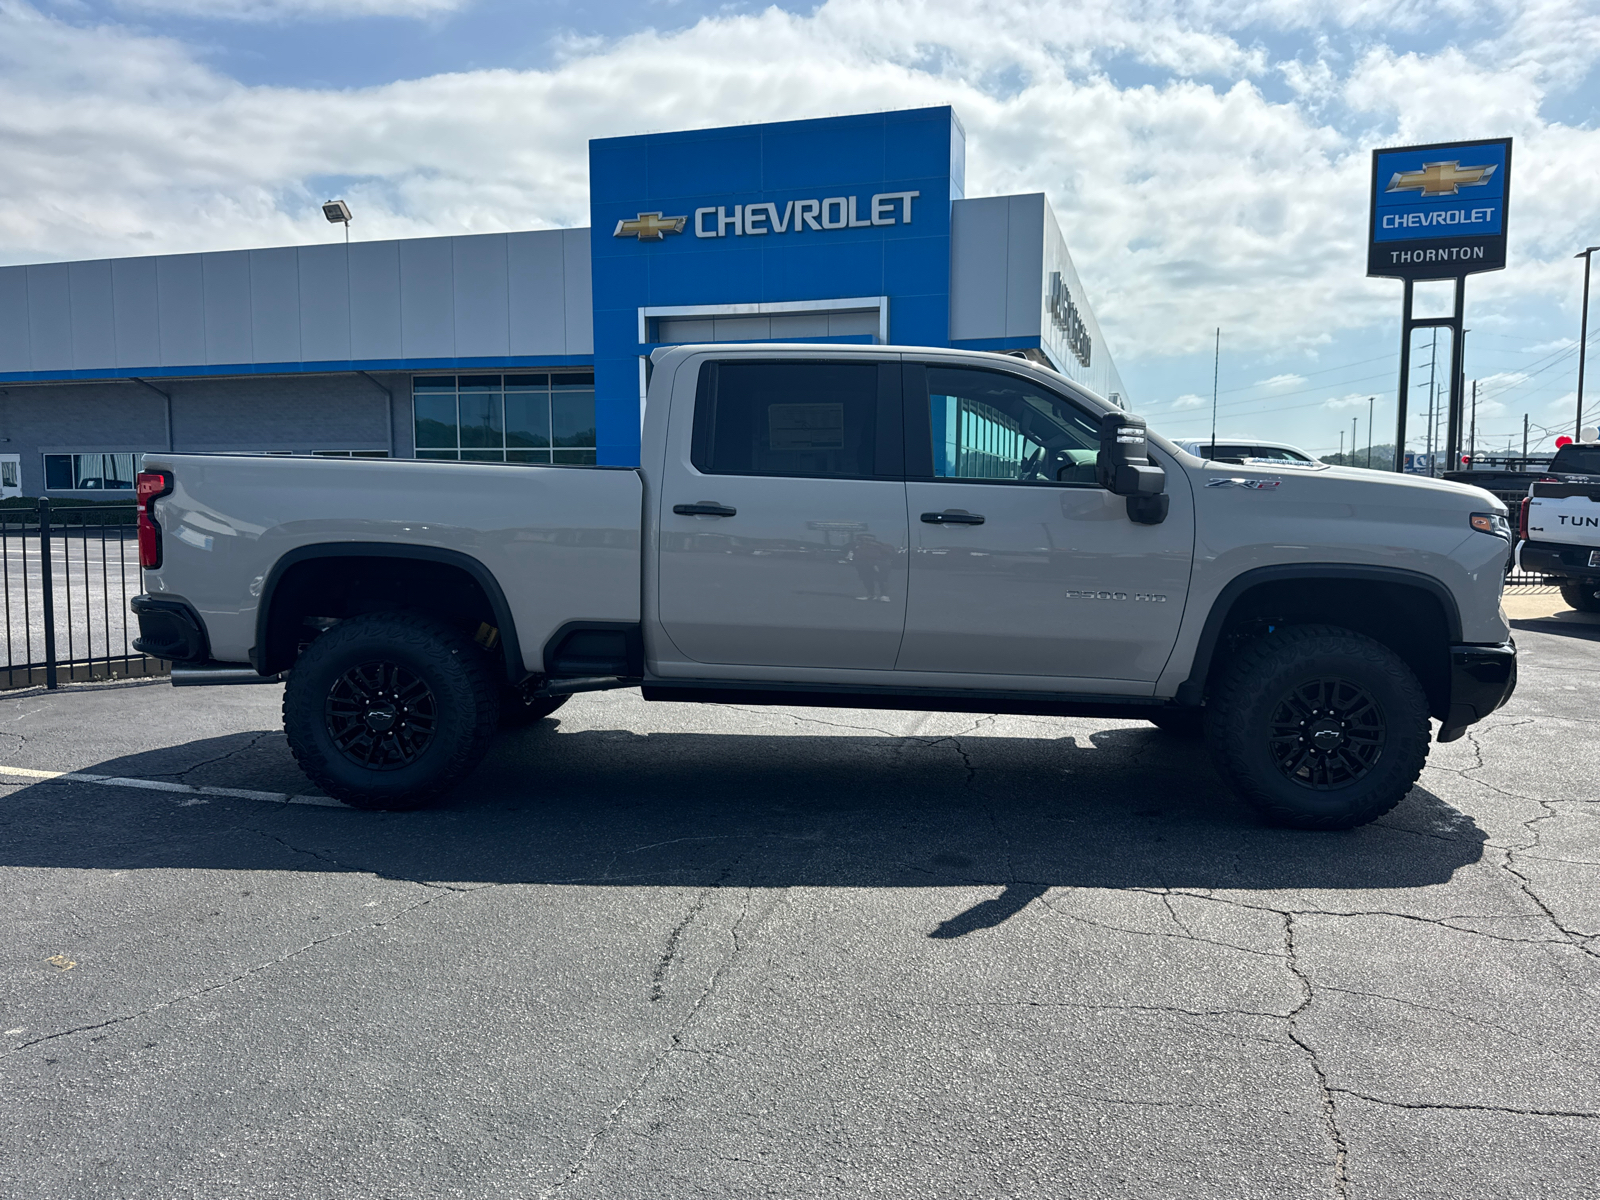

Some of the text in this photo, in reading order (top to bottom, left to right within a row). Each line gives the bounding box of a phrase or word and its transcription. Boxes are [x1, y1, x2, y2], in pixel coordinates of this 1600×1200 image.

[695, 191, 920, 238] CHEVROLET
[1383, 207, 1495, 229] CHEVROLET
[1391, 246, 1484, 263] THORNTON
[1065, 590, 1167, 603] 2500 HD
